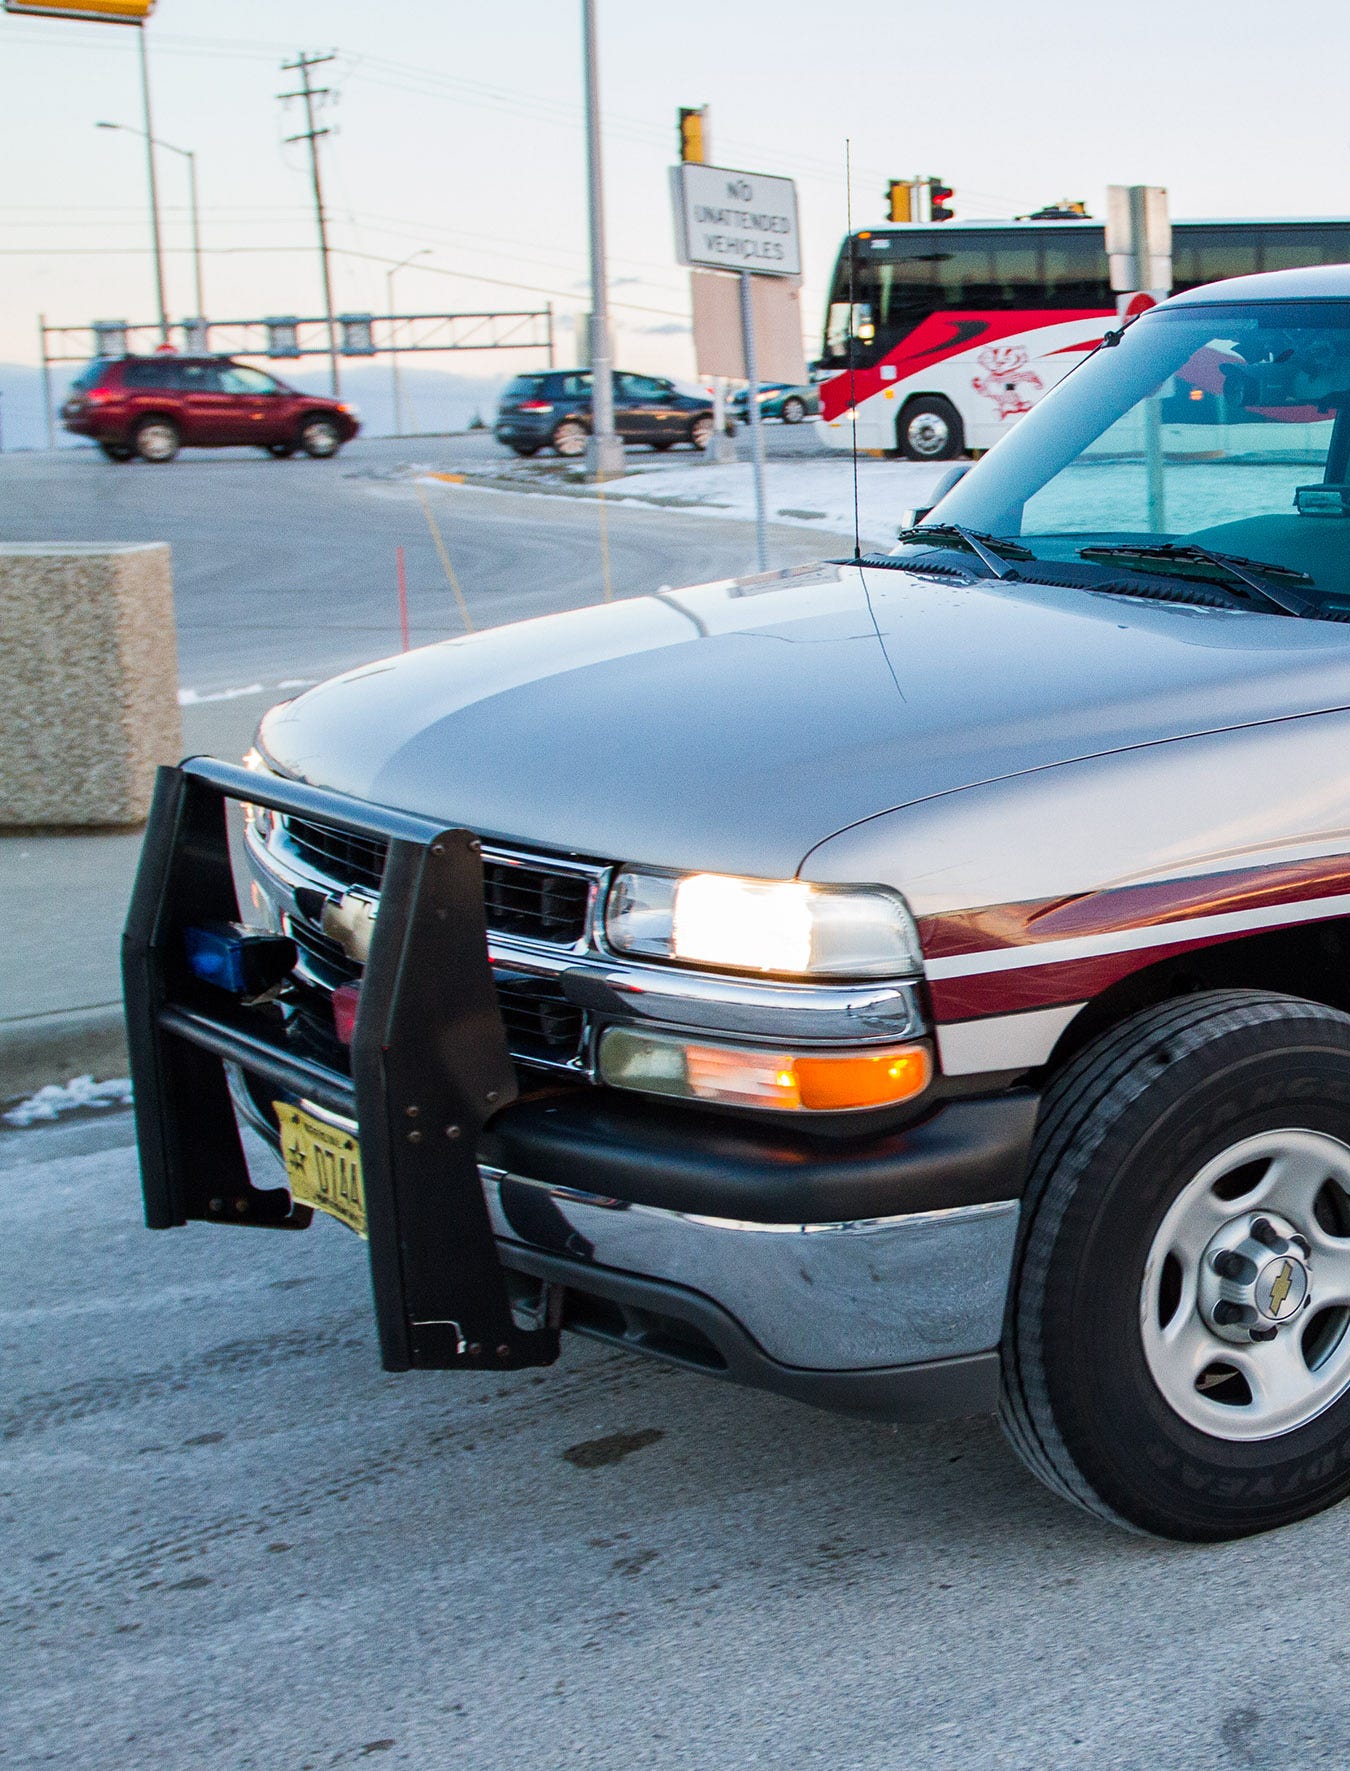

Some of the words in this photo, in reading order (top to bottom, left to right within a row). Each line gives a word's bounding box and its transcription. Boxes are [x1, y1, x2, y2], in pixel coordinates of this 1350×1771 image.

[727, 180, 753, 201] NO
[694, 205, 790, 234] UNATTENDED
[704, 234, 783, 260] VEHICLES
